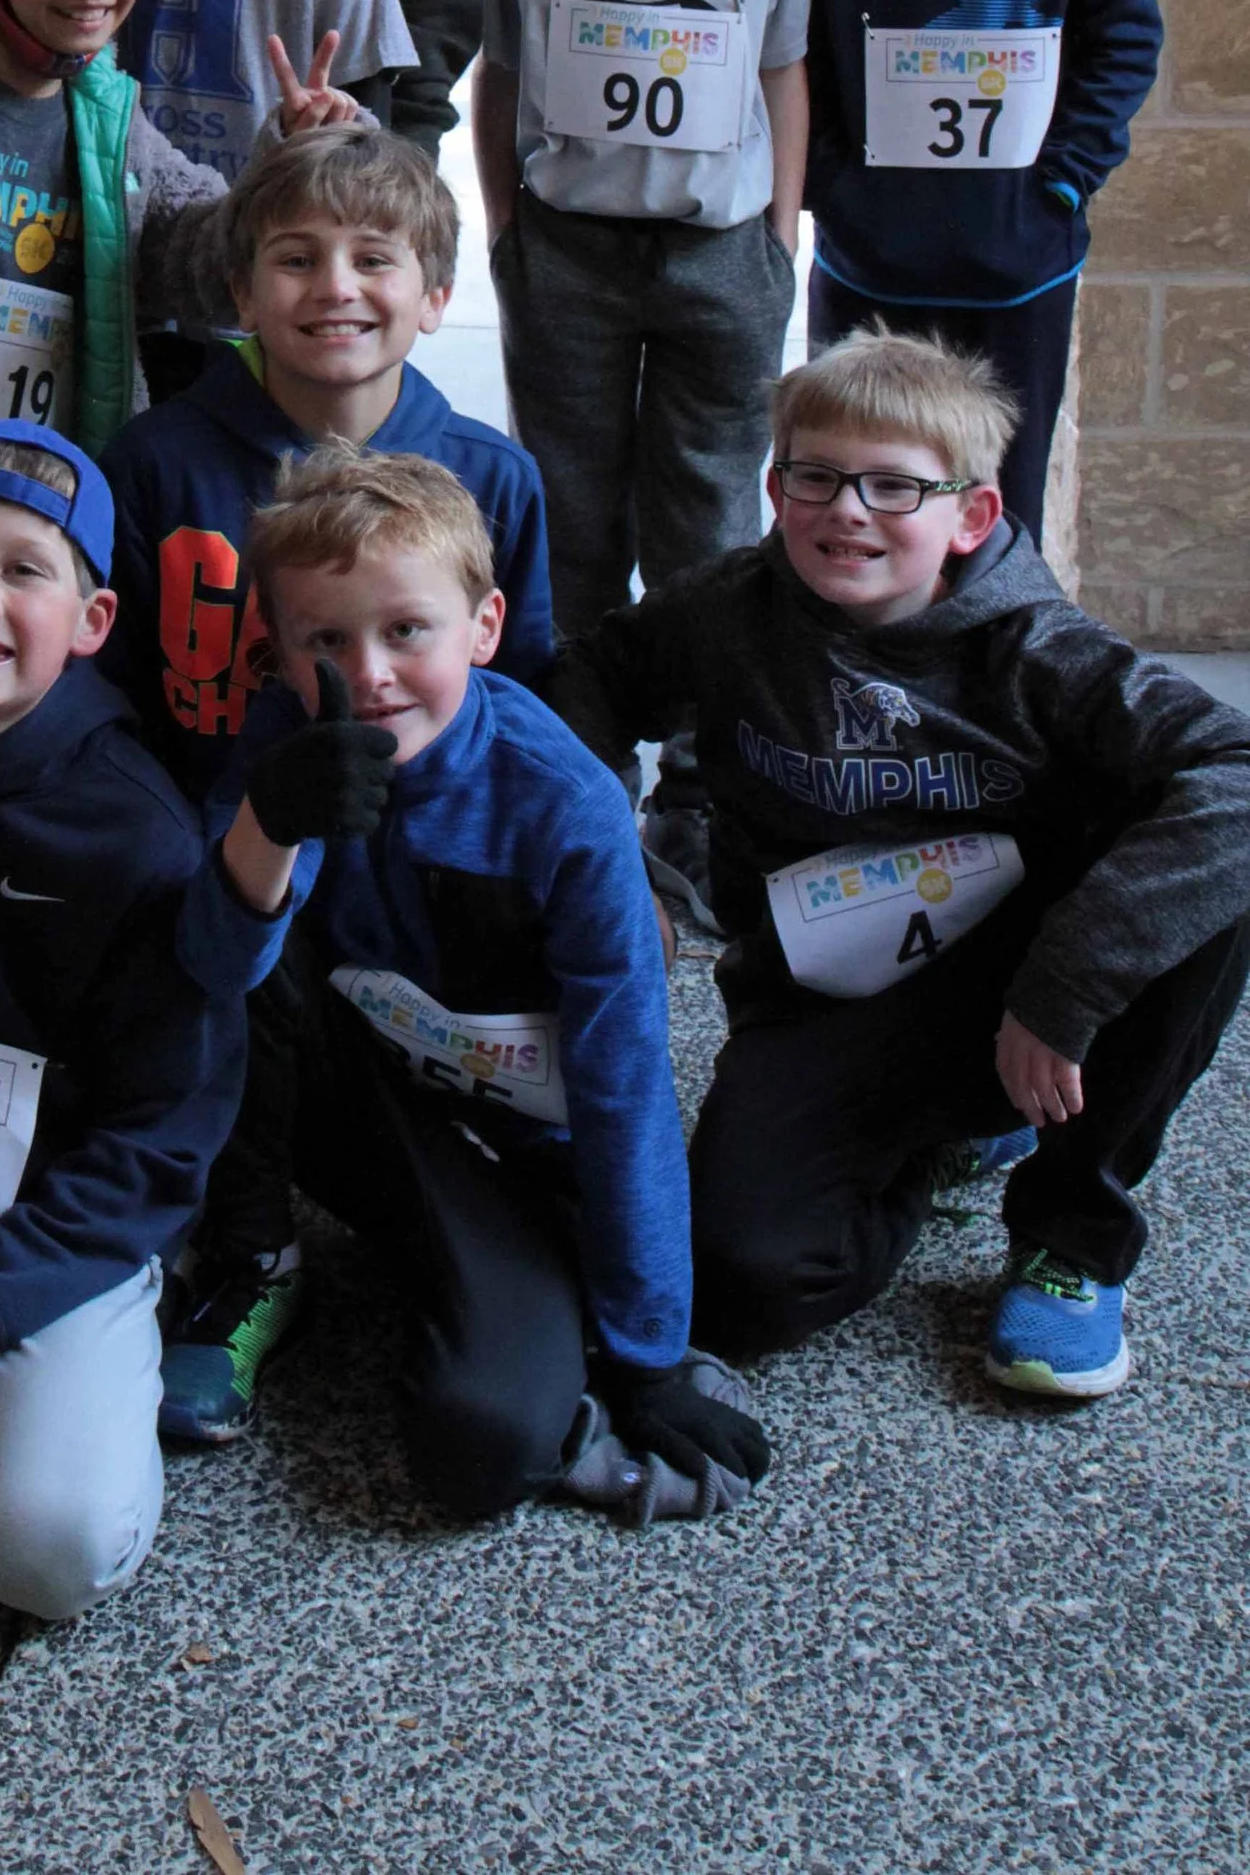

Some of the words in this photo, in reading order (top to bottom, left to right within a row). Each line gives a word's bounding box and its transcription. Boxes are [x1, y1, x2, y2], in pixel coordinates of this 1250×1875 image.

[578, 21, 719, 55] MEMPHIS
[895, 50, 1036, 74] MEMPHIS
[603, 72, 684, 137] 90
[927, 98, 1003, 158] 37
[738, 719, 1025, 815] MEMPHIS
[806, 836, 982, 908] MEMPHIS
[358, 985, 538, 1074] MEMPHIS
